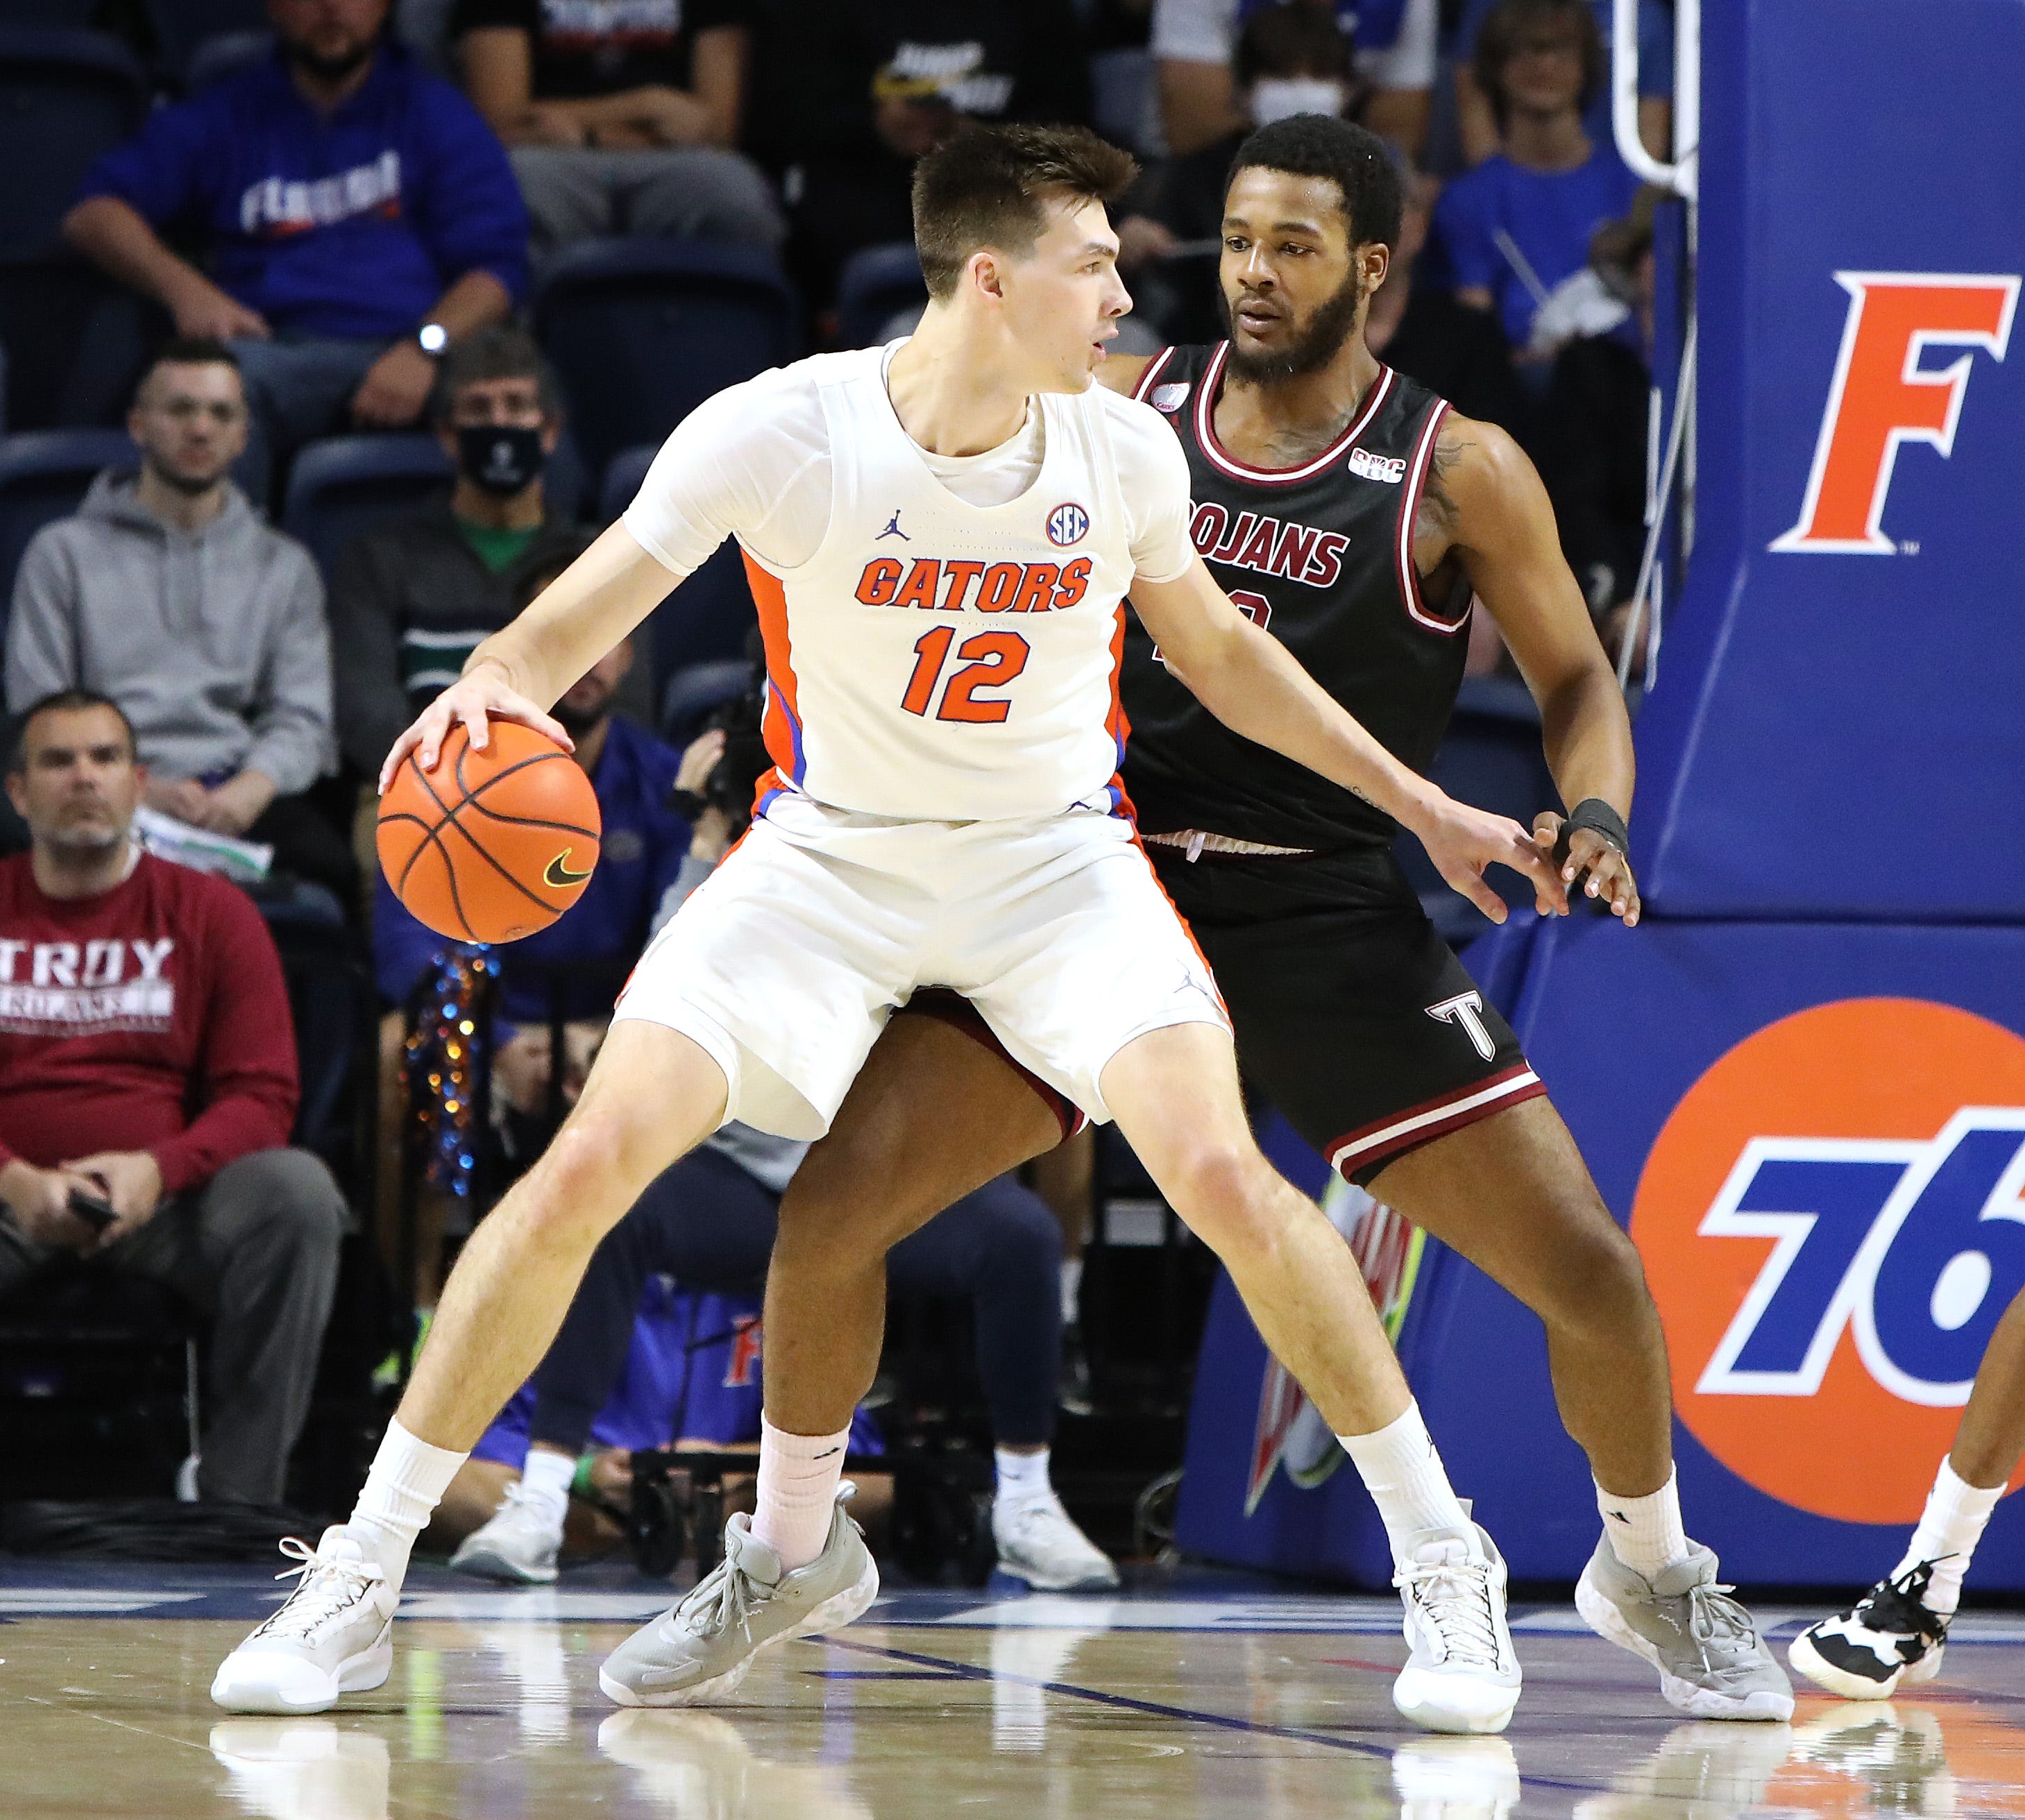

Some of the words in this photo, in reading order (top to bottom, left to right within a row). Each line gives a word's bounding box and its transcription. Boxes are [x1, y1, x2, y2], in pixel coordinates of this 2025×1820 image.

[1767, 270, 2024, 555] F
[1048, 505, 1088, 545] SEC
[1189, 500, 1351, 588] OJANS
[854, 557, 1093, 613] GATORS
[901, 625, 1031, 724] 12
[0, 938, 175, 988] TROY
[1693, 1105, 2025, 1408] 76
